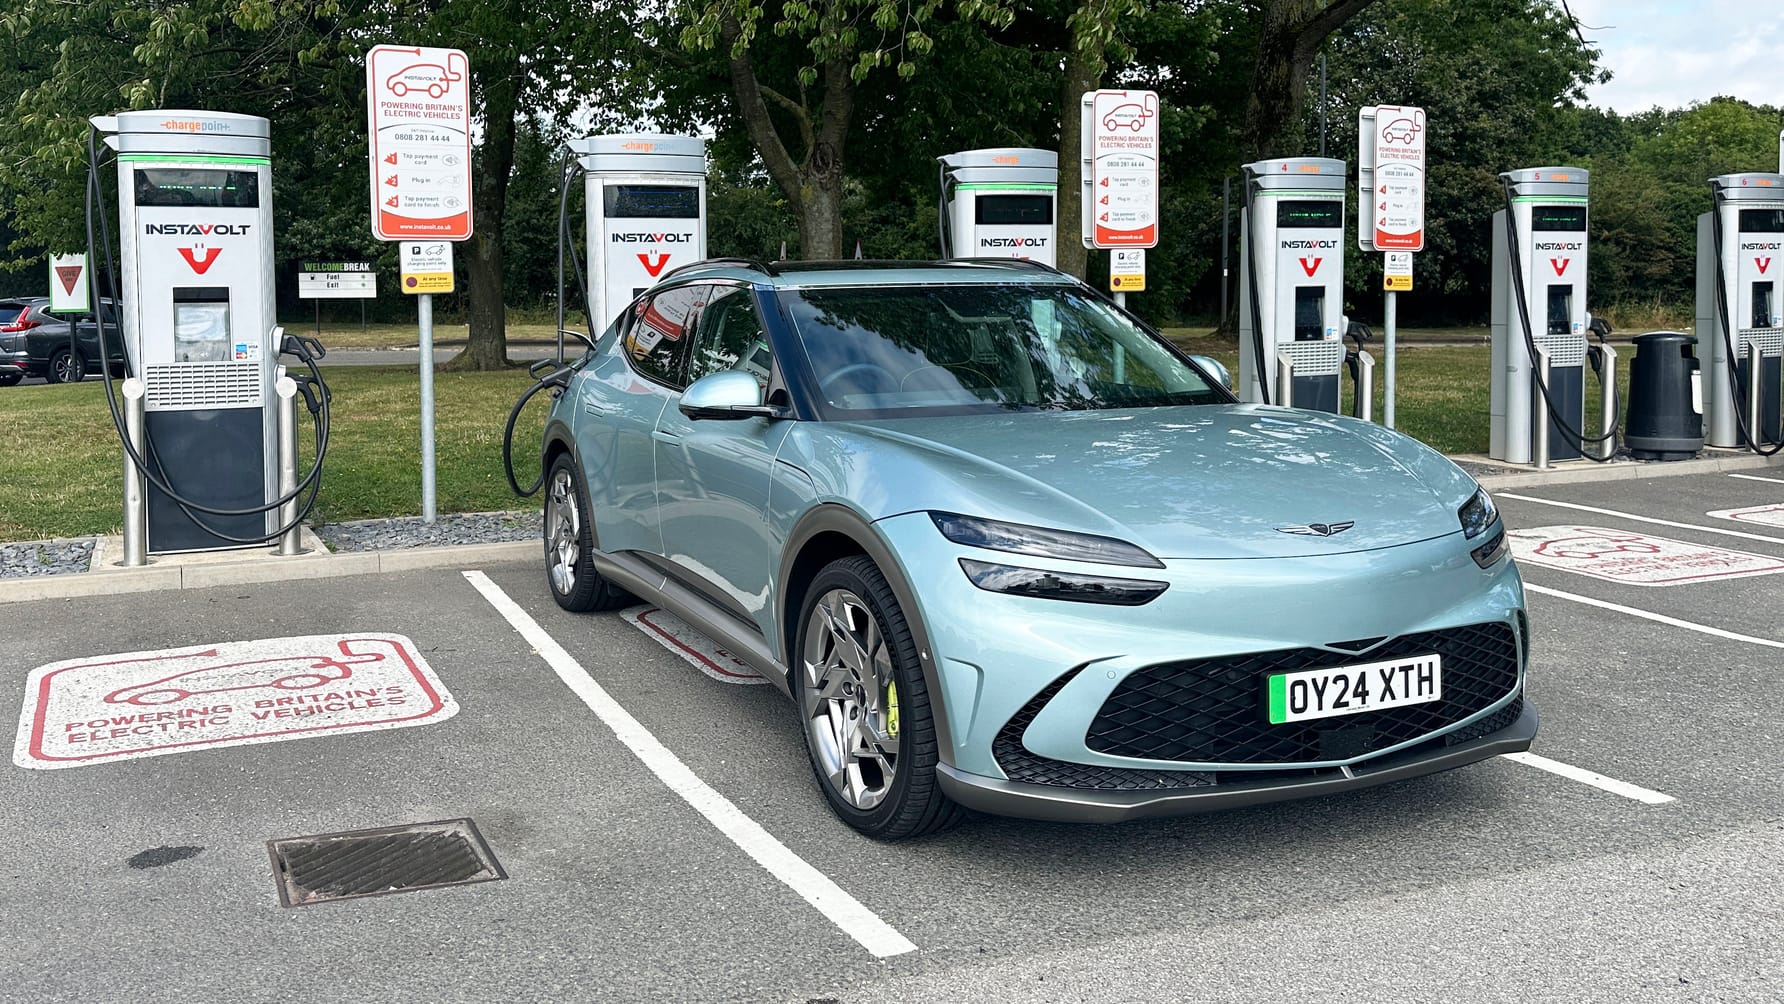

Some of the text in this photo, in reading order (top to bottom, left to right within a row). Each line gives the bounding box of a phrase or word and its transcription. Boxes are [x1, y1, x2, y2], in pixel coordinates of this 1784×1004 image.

[381, 101, 463, 112] POWERING BRITAIN'S
[423, 111, 461, 120] VEHICLES
[1282, 164, 1288, 172] 4
[146, 224, 251, 235] INSTAVOLT
[612, 233, 693, 242] INSTAVOLT
[981, 238, 1047, 247] INSTAVOLT
[1282, 240, 1337, 248] INSTAVOLT
[1290, 662, 1434, 714] OY24 XTH
[64, 686, 404, 732] POWERING BRITAIN'S
[68, 696, 406, 744] ELECTRIC VEHICLES
